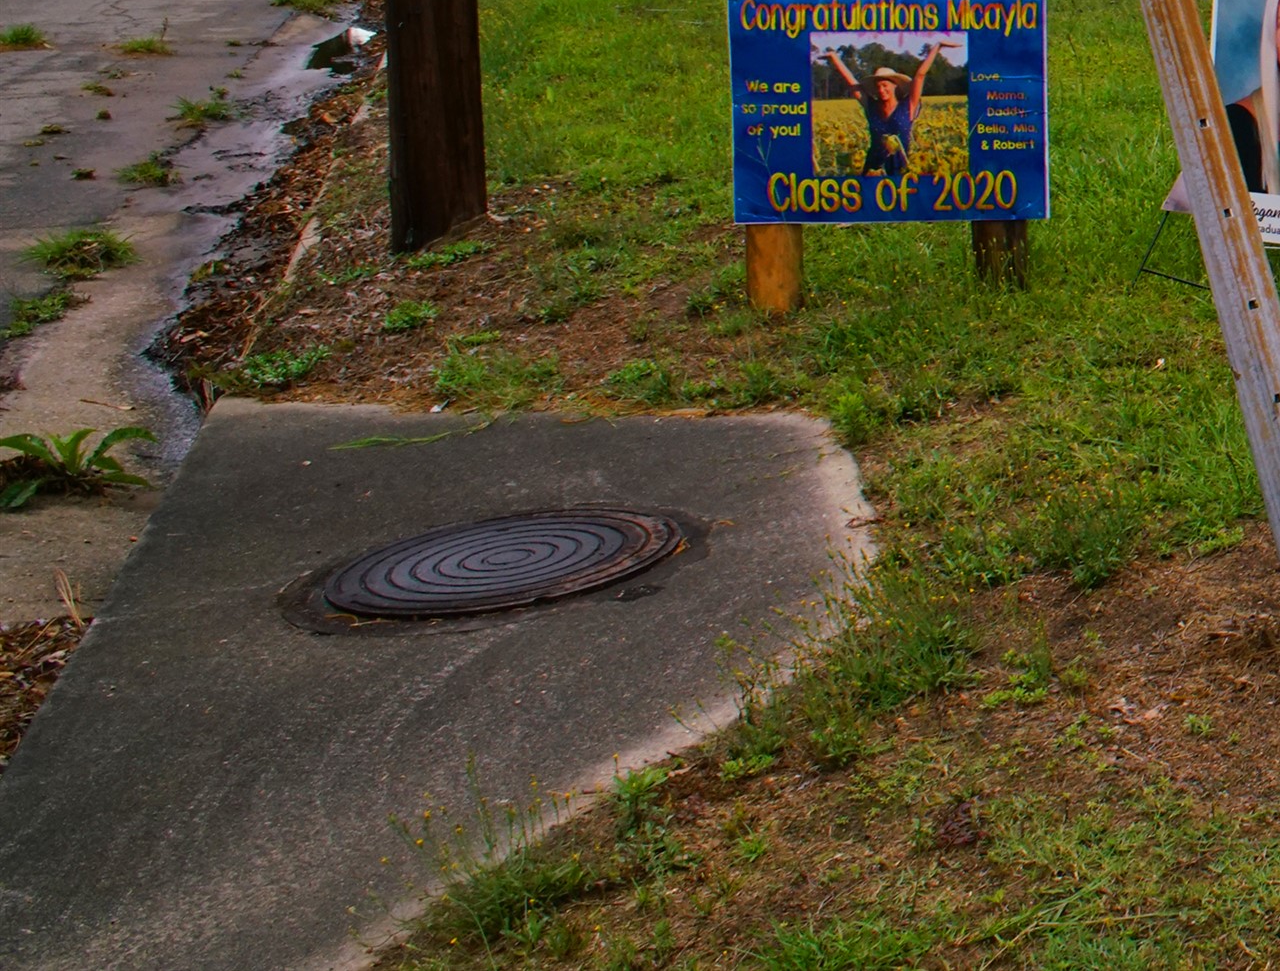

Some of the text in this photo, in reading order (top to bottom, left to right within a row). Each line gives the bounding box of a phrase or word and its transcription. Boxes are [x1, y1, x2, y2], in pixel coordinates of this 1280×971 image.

[745, 79, 801, 93] We are
[741, 101, 807, 117] so proud
[747, 123, 763, 135] of
[981, 139, 1035, 150] & Robert
[767, 170, 1018, 213] Class of 2020
